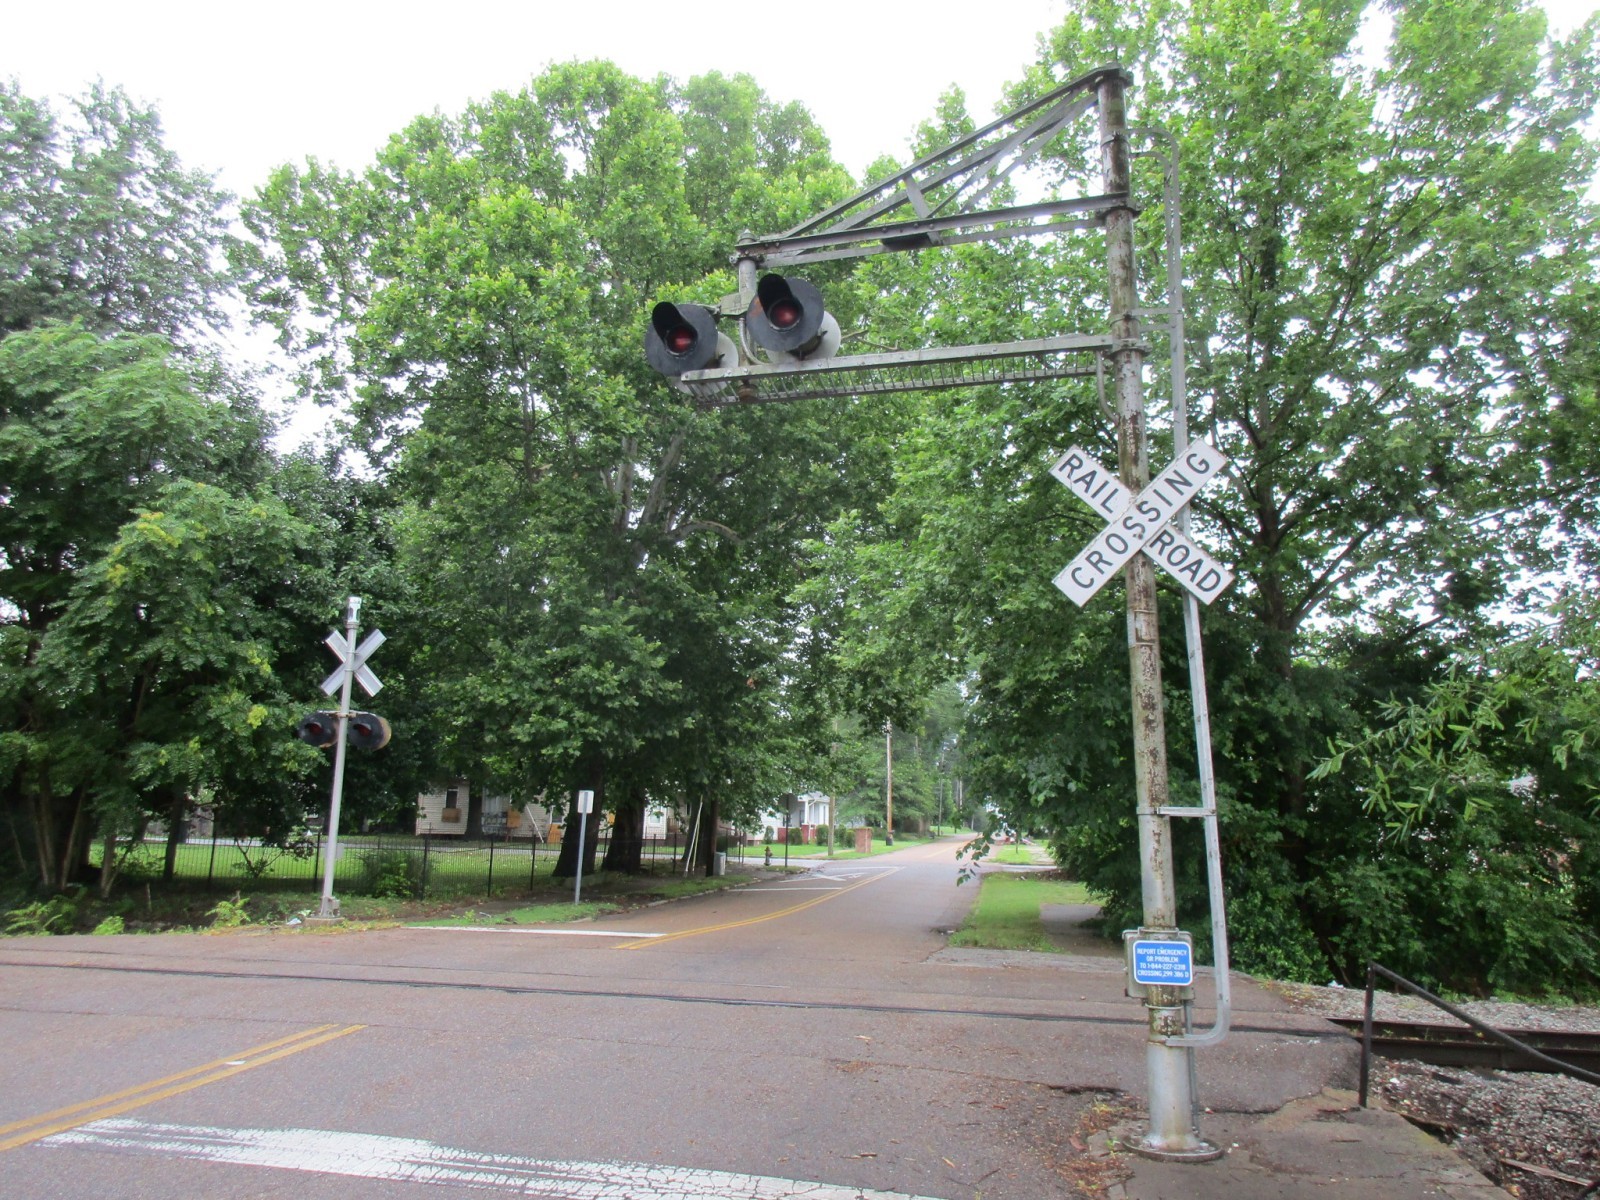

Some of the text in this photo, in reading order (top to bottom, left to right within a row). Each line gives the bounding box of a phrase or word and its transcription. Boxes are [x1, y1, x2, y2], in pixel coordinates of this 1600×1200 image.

[1058, 453, 1119, 514] RAIL
[1071, 453, 1210, 589] CROSSING
[1149, 529, 1221, 592] ROAD
